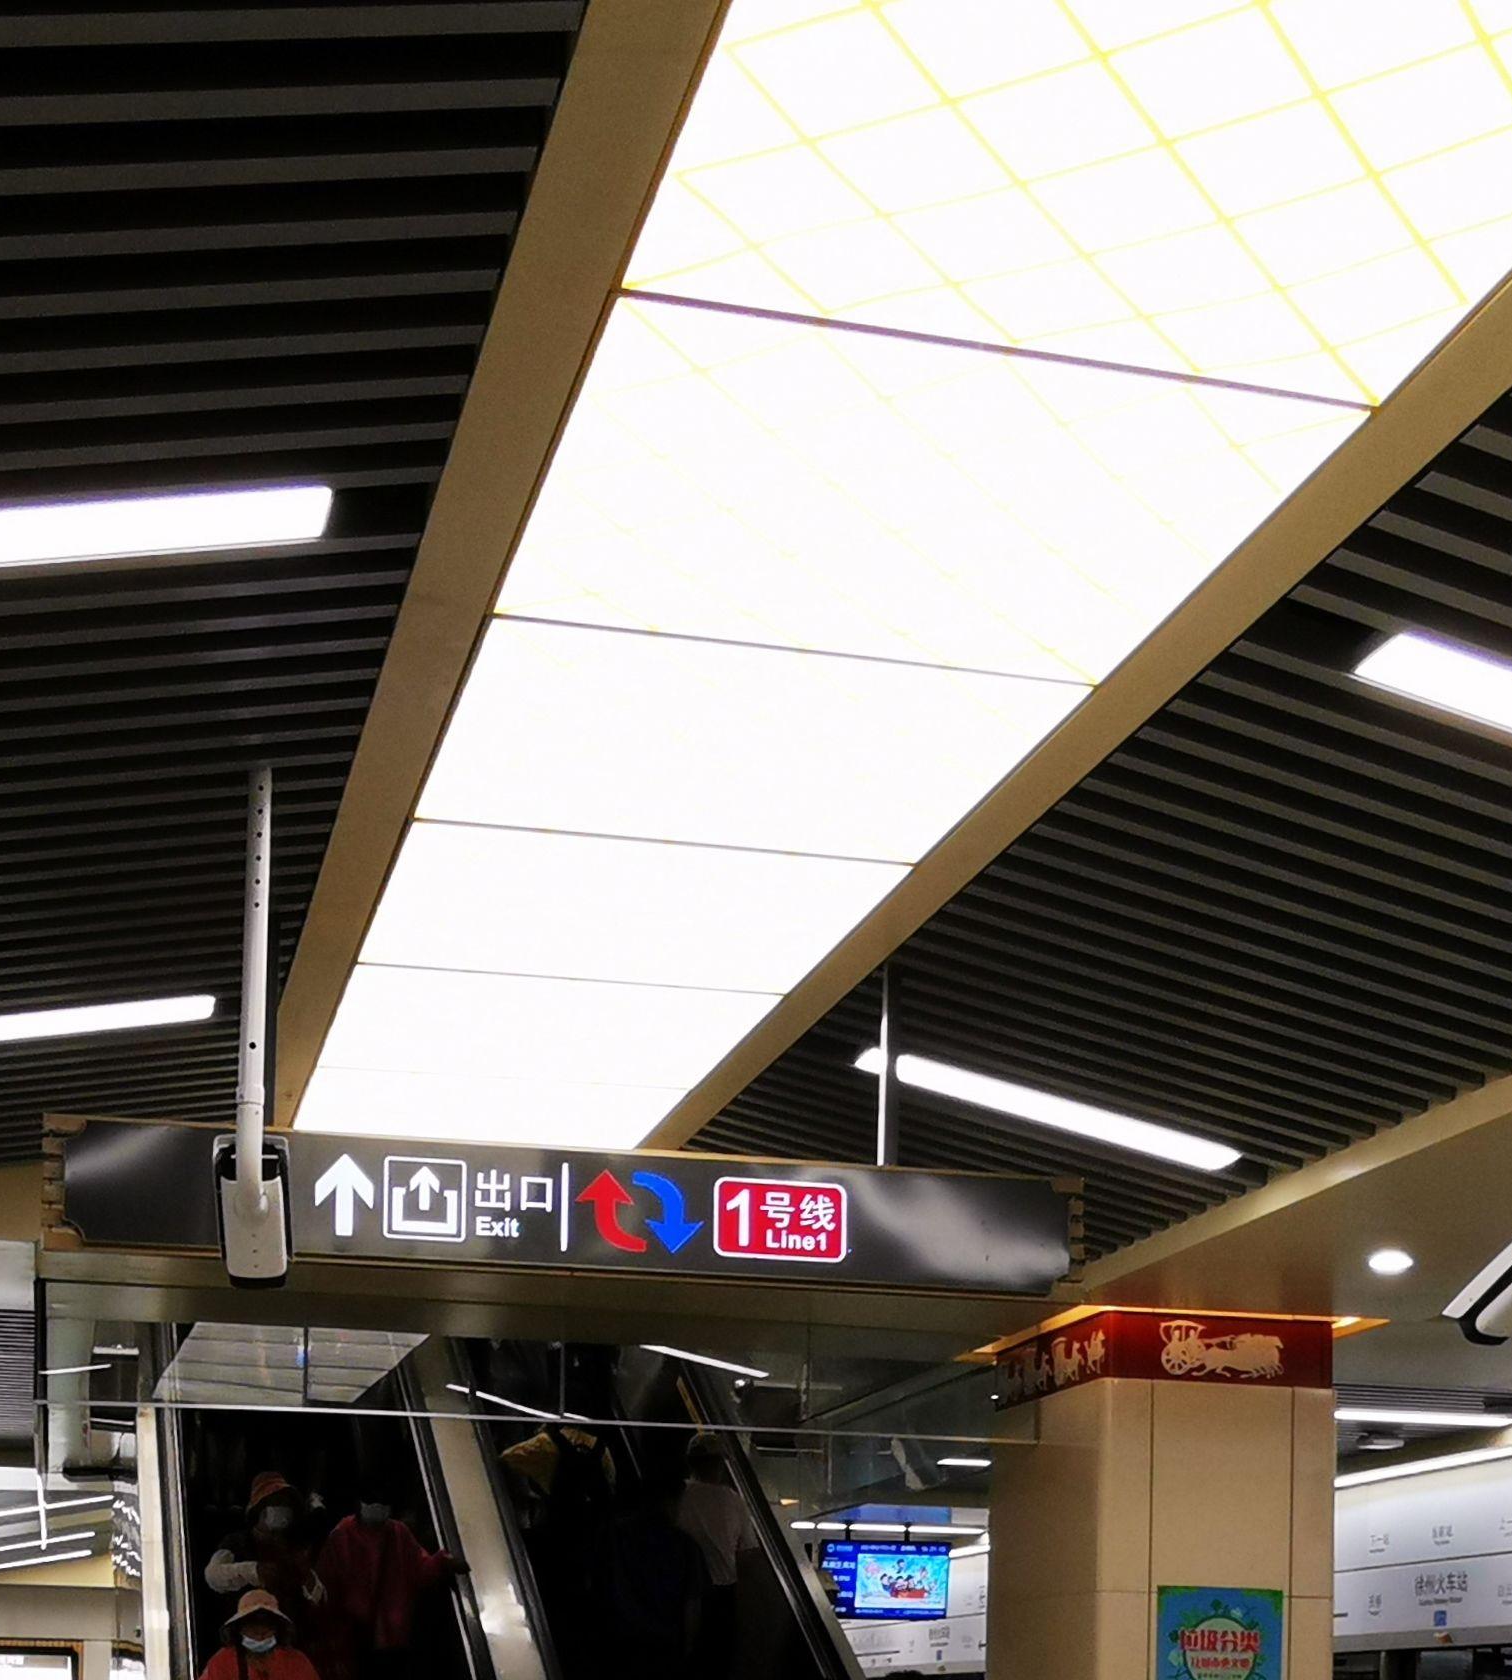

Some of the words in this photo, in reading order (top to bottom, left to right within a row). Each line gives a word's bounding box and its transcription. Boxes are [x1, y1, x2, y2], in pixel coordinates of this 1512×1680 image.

[473, 1168, 553, 1213] 出口
[475, 1215, 521, 1239] Exit
[725, 1187, 836, 1248] 1号线
[765, 1228, 828, 1253] Line1
